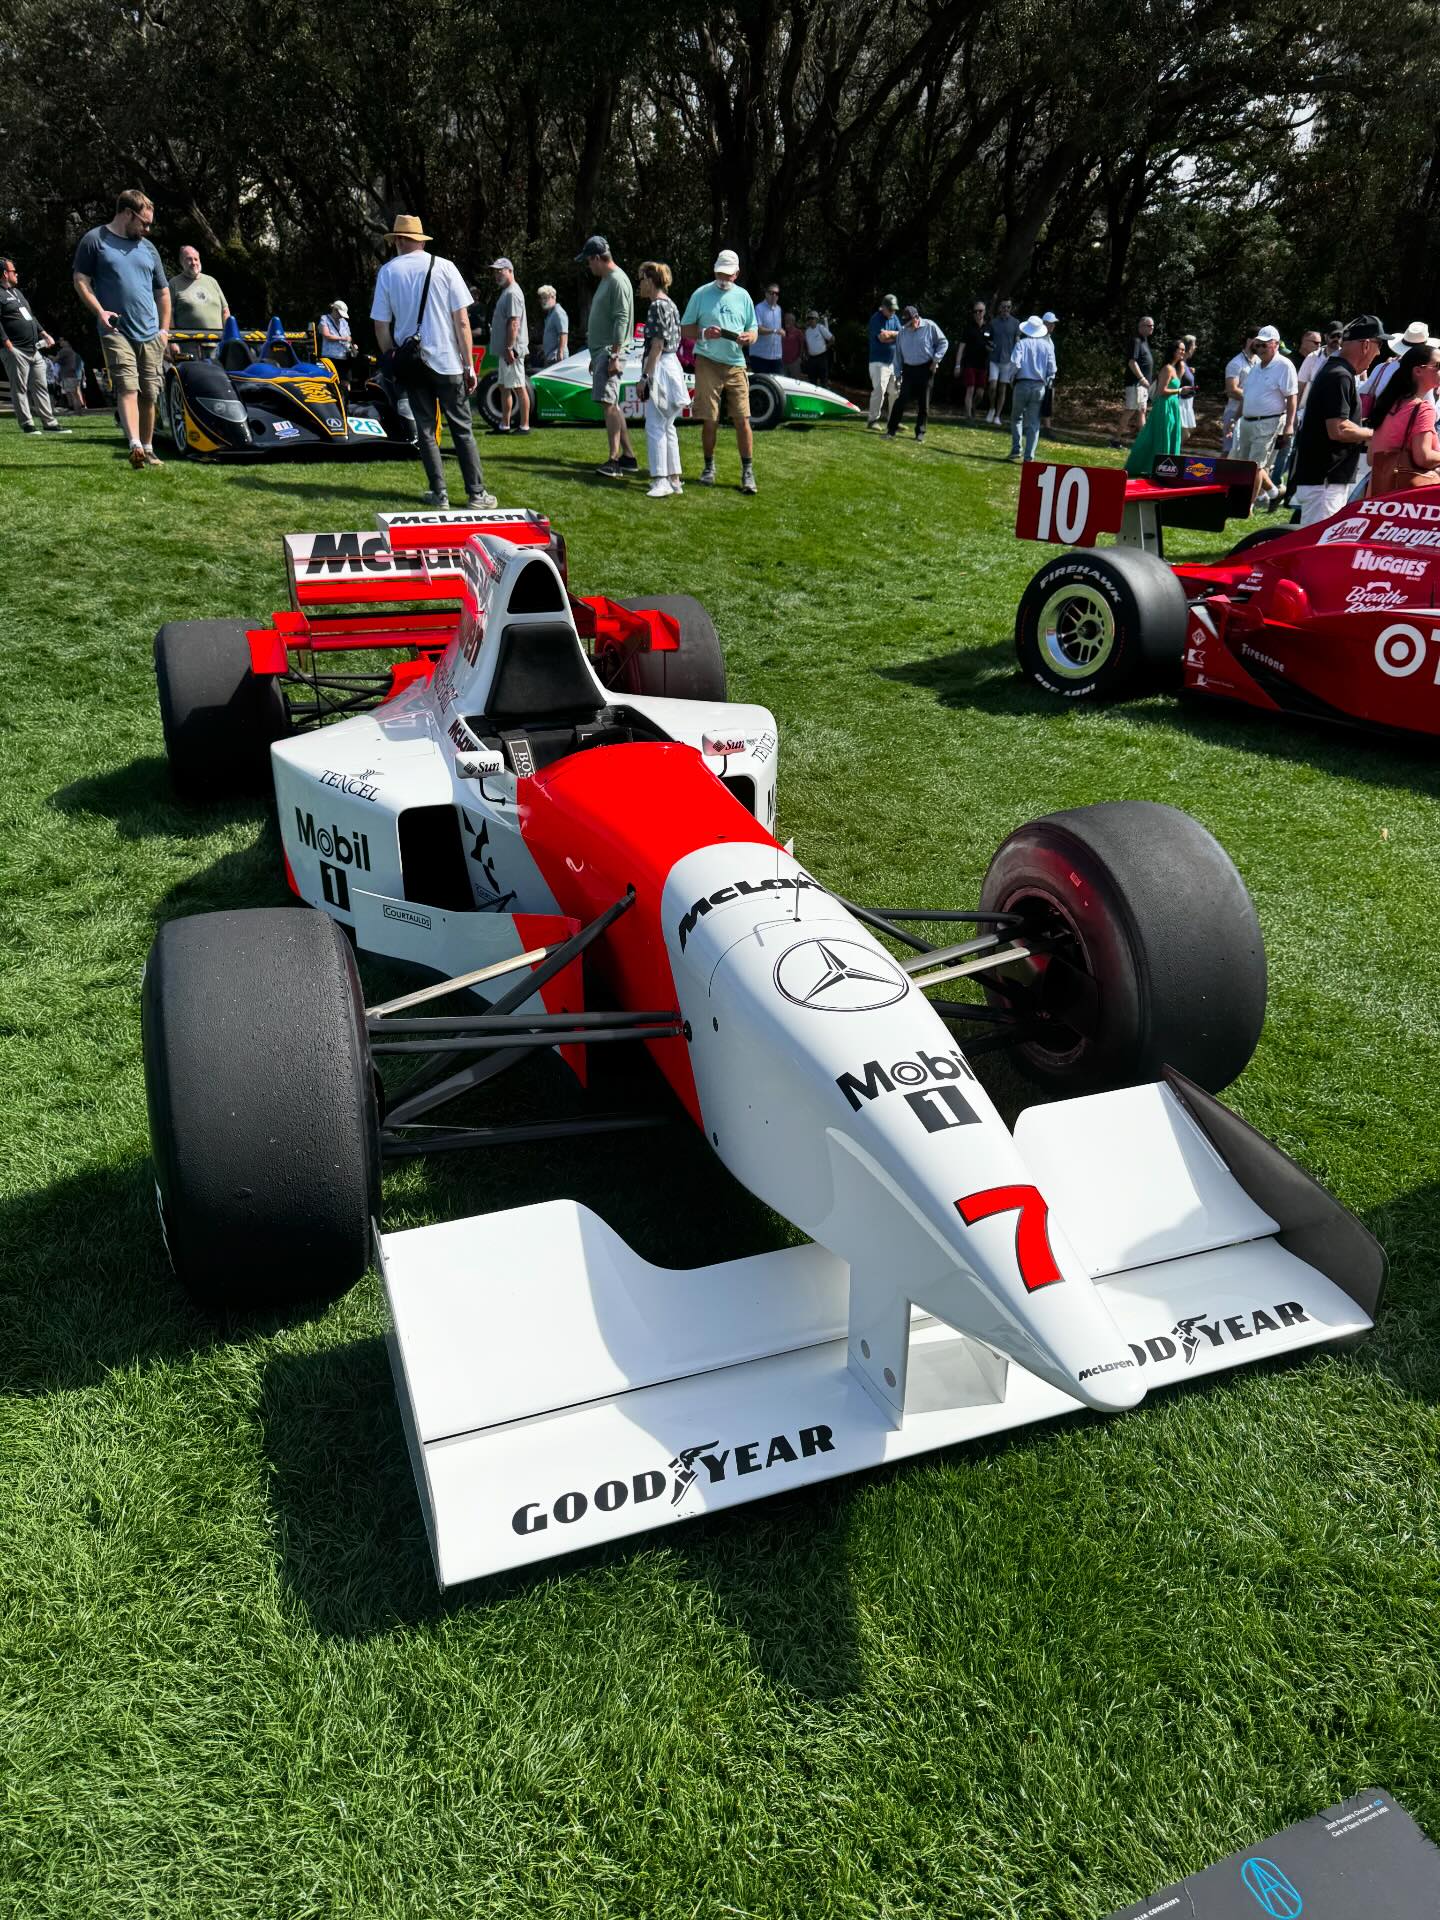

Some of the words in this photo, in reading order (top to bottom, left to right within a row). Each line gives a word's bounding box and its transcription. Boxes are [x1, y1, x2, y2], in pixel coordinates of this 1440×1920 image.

[349, 420, 383, 434] 26
[1157, 465, 1177, 473] PEAK
[1037, 465, 1090, 544] 10
[1357, 501, 1440, 521] HOND
[389, 514, 526, 525] McLaren
[1370, 521, 1440, 547] Energiz
[1352, 549, 1429, 577] HUGGIES
[1040, 565, 1122, 603] FIREHAWK
[1346, 586, 1409, 604] Breathe
[1241, 642, 1285, 673] Firestone
[725, 740, 745, 750] Sun
[477, 761, 500, 773] Sun
[318, 769, 381, 802] TENCEL
[295, 807, 371, 872] Mobil
[323, 863, 346, 909] 1
[386, 906, 430, 928] COURTAULDS
[678, 878, 828, 954] McLar
[914, 1088, 970, 1128] 1
[954, 1184, 1065, 1293] 7
[1078, 1359, 1134, 1382] McLaren
[1148, 1897, 1180, 1916] CONCOURS
